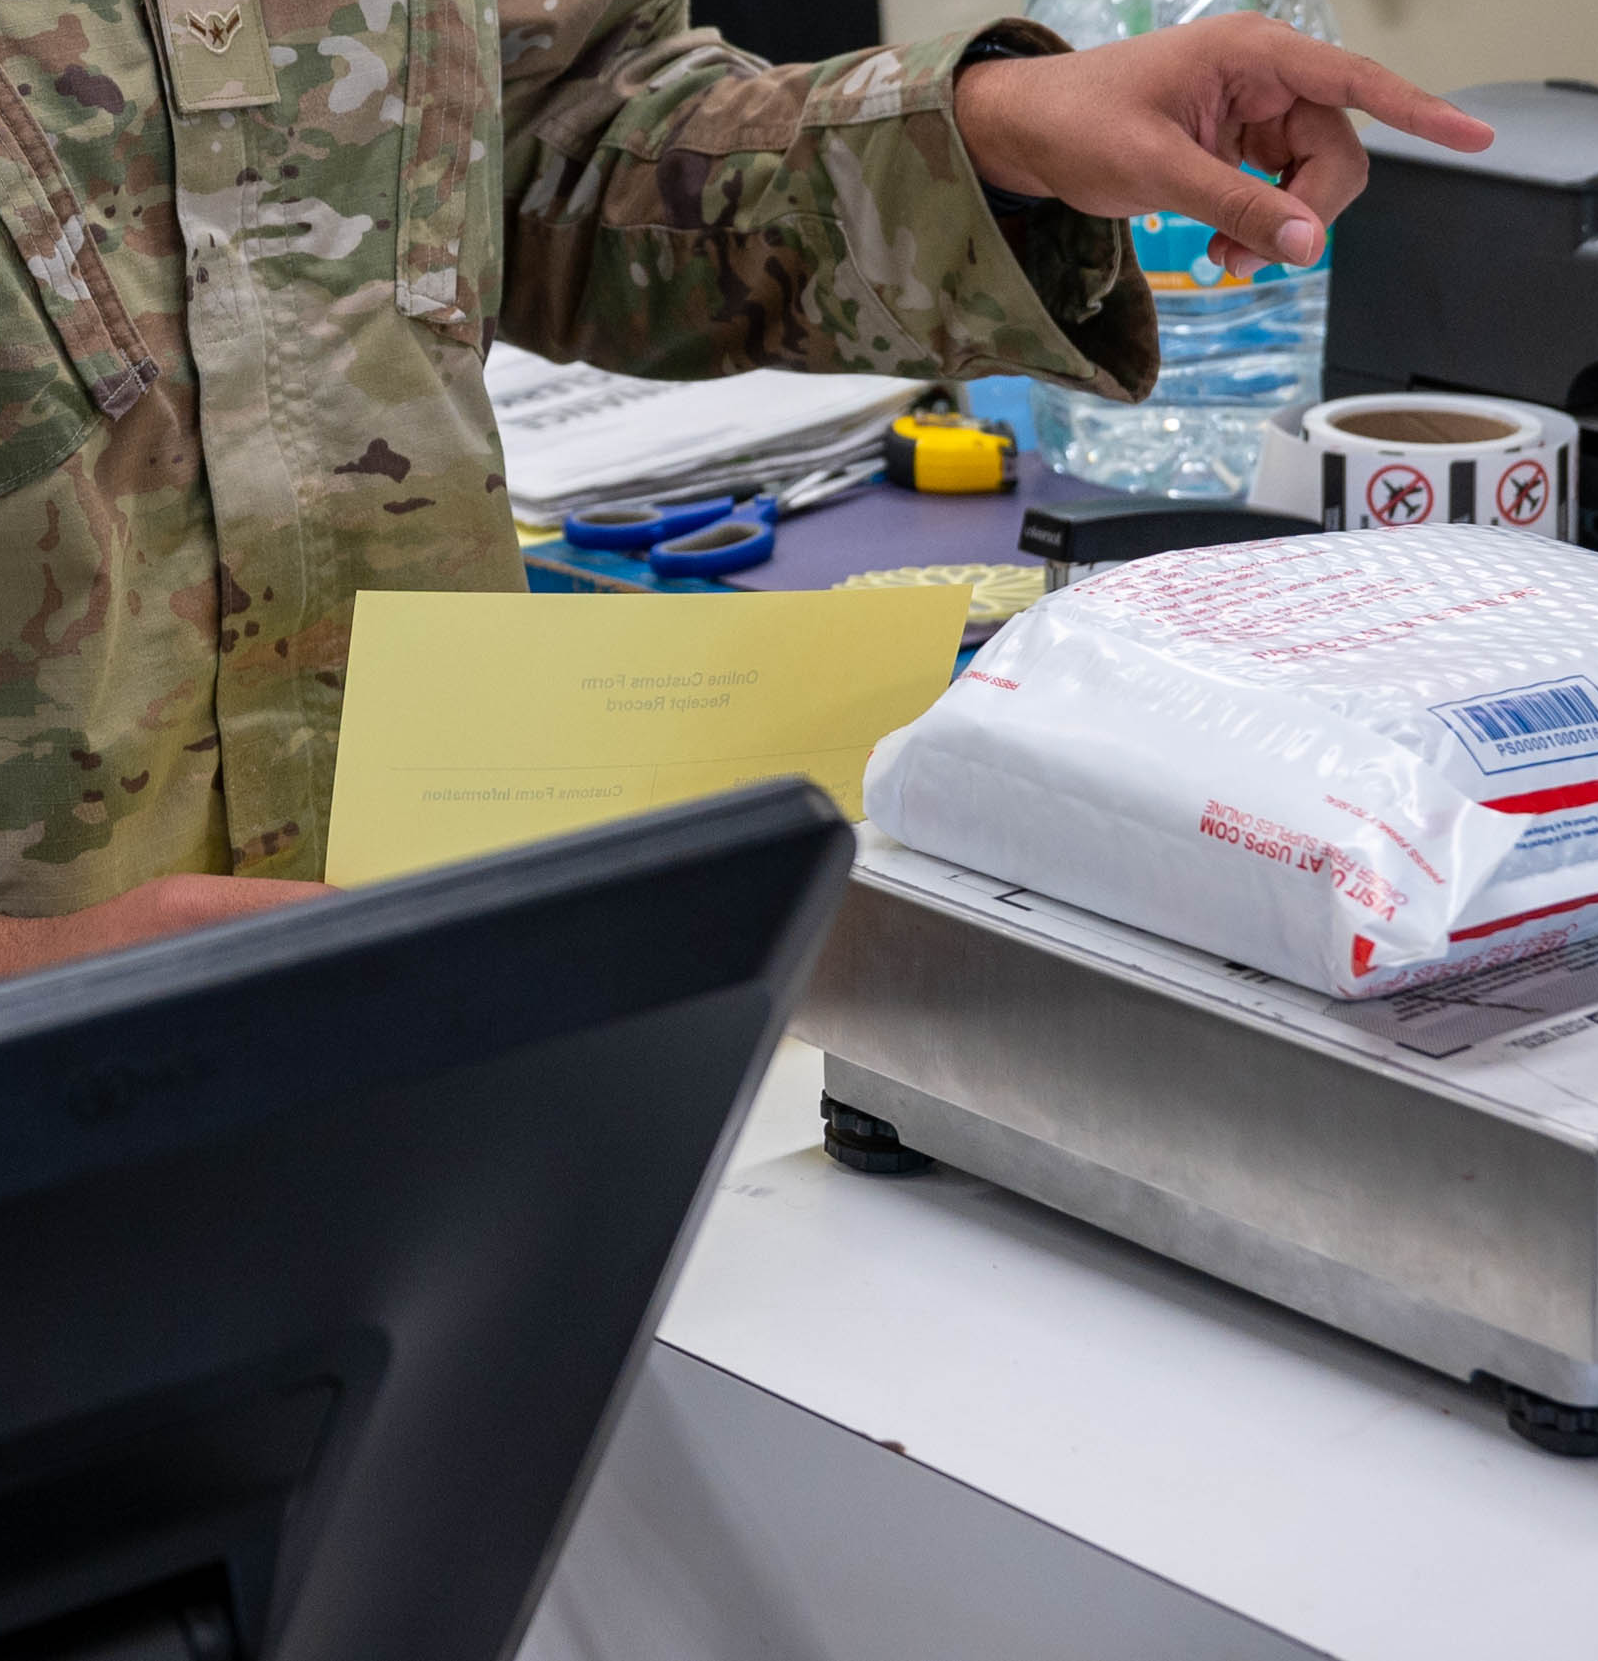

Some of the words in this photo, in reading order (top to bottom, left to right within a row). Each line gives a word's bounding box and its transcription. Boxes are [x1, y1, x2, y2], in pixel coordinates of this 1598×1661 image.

[1205, 800, 1253, 831] ONLINE
[1200, 817, 1292, 865] USPS.COM
[1252, 819, 1316, 852] SUPPLIES
[1296, 853, 1324, 874] AT
